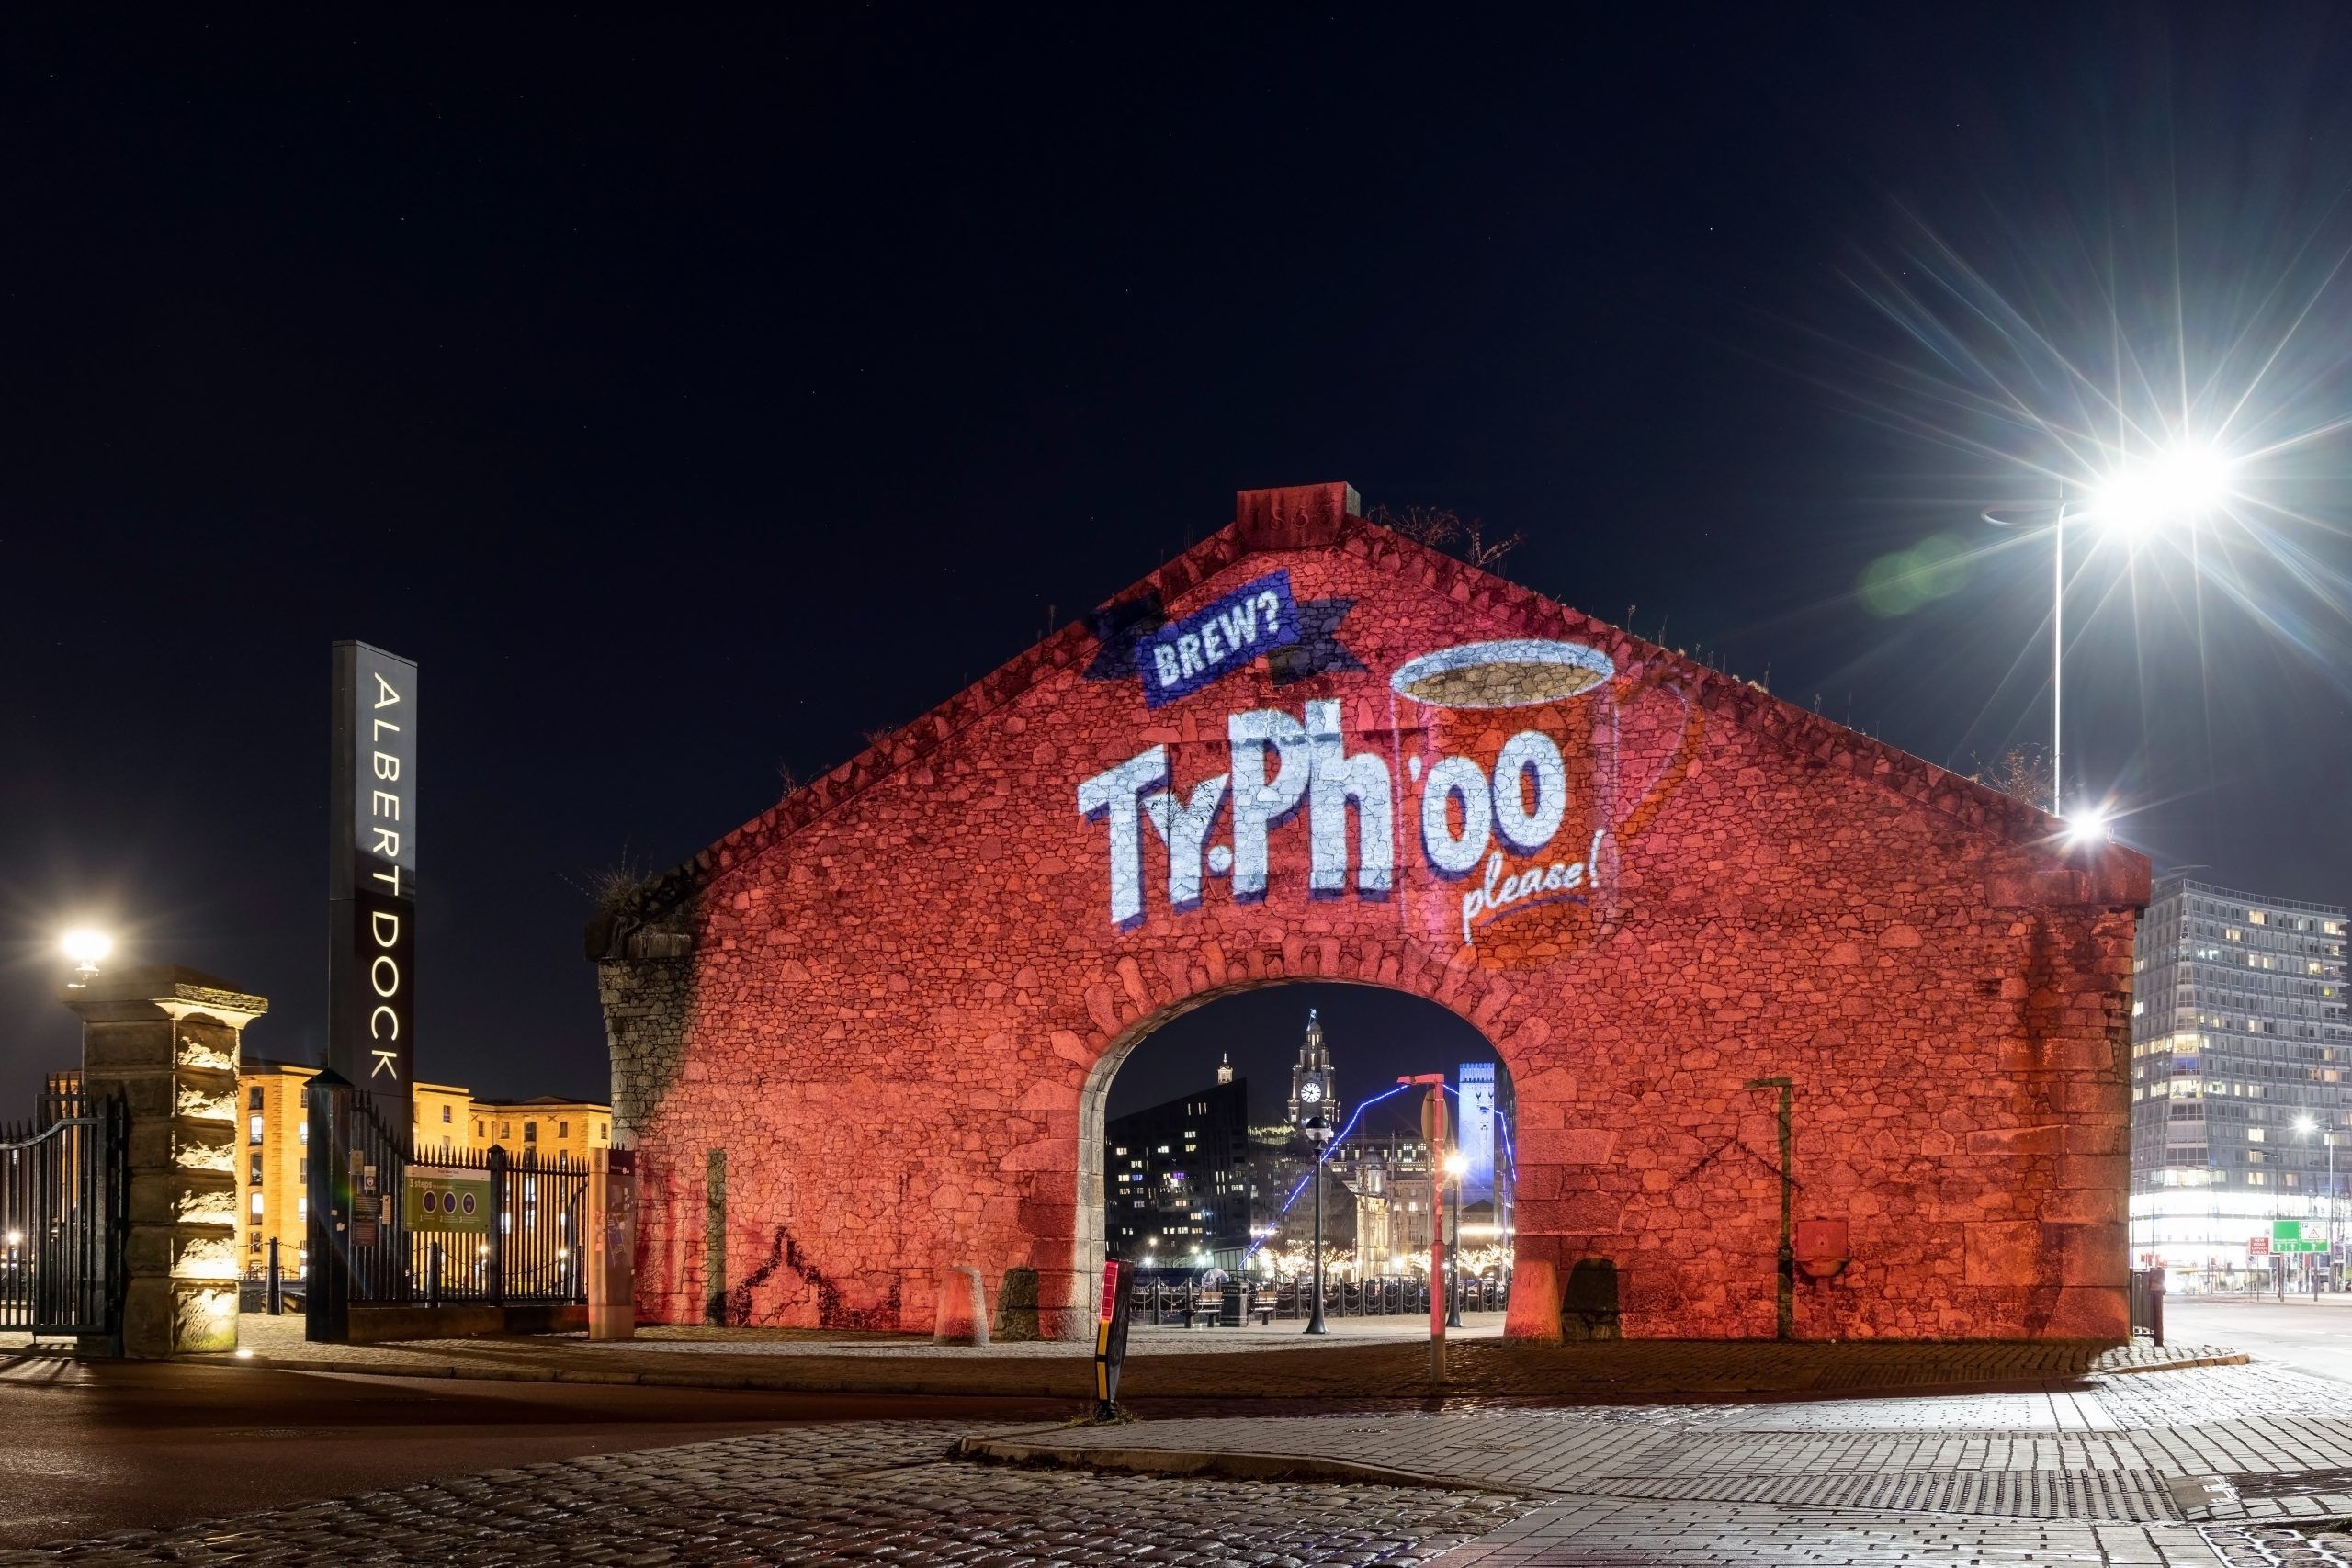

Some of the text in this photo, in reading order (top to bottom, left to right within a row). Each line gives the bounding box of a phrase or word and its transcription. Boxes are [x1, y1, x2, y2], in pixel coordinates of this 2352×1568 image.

[1153, 591, 1279, 688] BREW?
[371, 671, 401, 1081] ALBERT DOCK
[1462, 829, 1606, 947] please!
[409, 1178, 433, 1190] 3 steps
